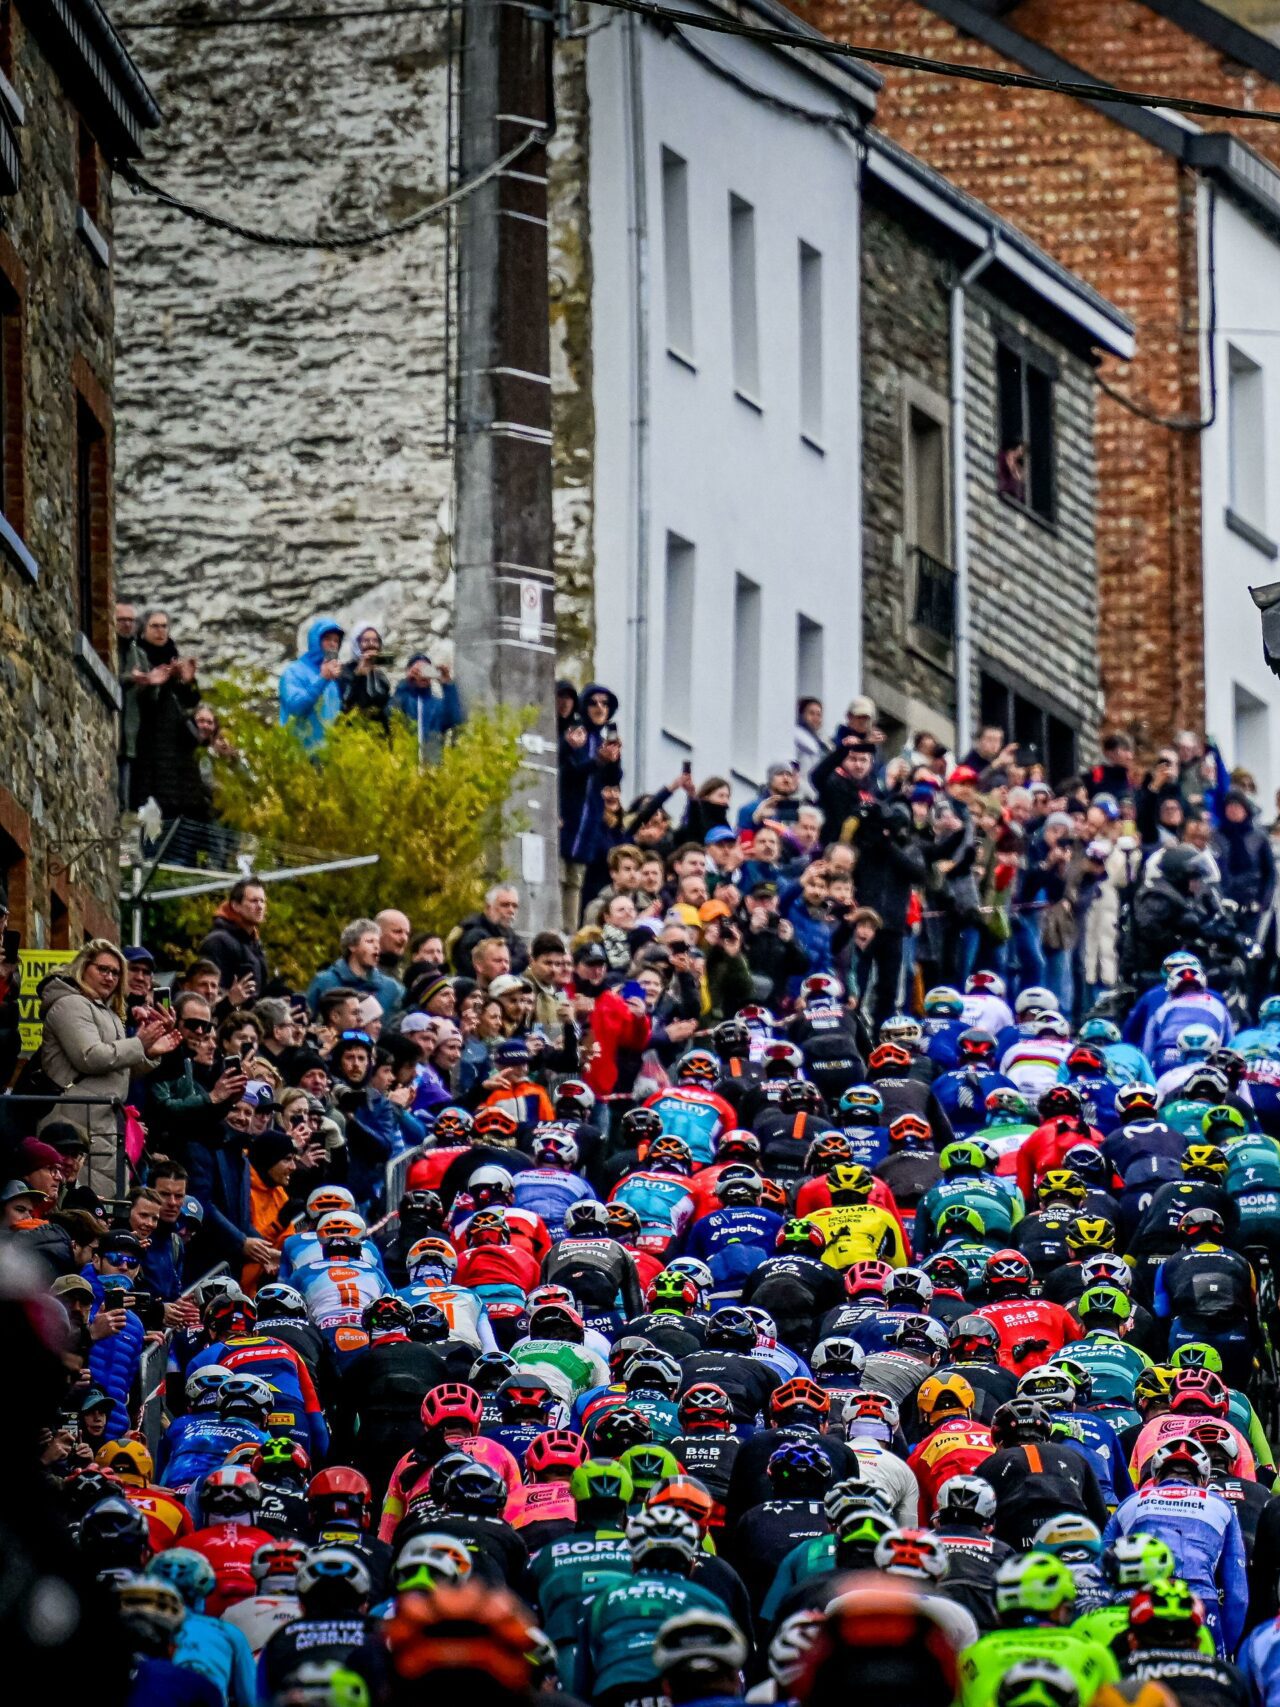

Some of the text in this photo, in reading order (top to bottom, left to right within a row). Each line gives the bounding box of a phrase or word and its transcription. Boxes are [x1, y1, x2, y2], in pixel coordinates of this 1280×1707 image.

[659, 1098, 710, 1117] dstny
[1239, 1194, 1276, 1206] BORA
[837, 1206, 876, 1214] VISMA
[720, 1224, 764, 1236] baloise
[635, 1236, 664, 1247] APS
[331, 1269, 356, 1278] postnl
[487, 1304, 517, 1313] APS
[1003, 1310, 1039, 1323] B&B
[1006, 1317, 1039, 1328] HOTELS
[338, 1333, 368, 1343] postnl
[223, 1348, 290, 1366] TREK
[1059, 1344, 1127, 1358] BORA
[935, 1436, 959, 1448] Uno
[686, 1446, 721, 1456] B&B
[1205, 1482, 1242, 1491] AE
[1148, 1489, 1200, 1497] Alpecin
[524, 1498, 570, 1512] Education
[551, 1540, 630, 1557] BORA
[554, 1551, 632, 1567] hansgrohe
